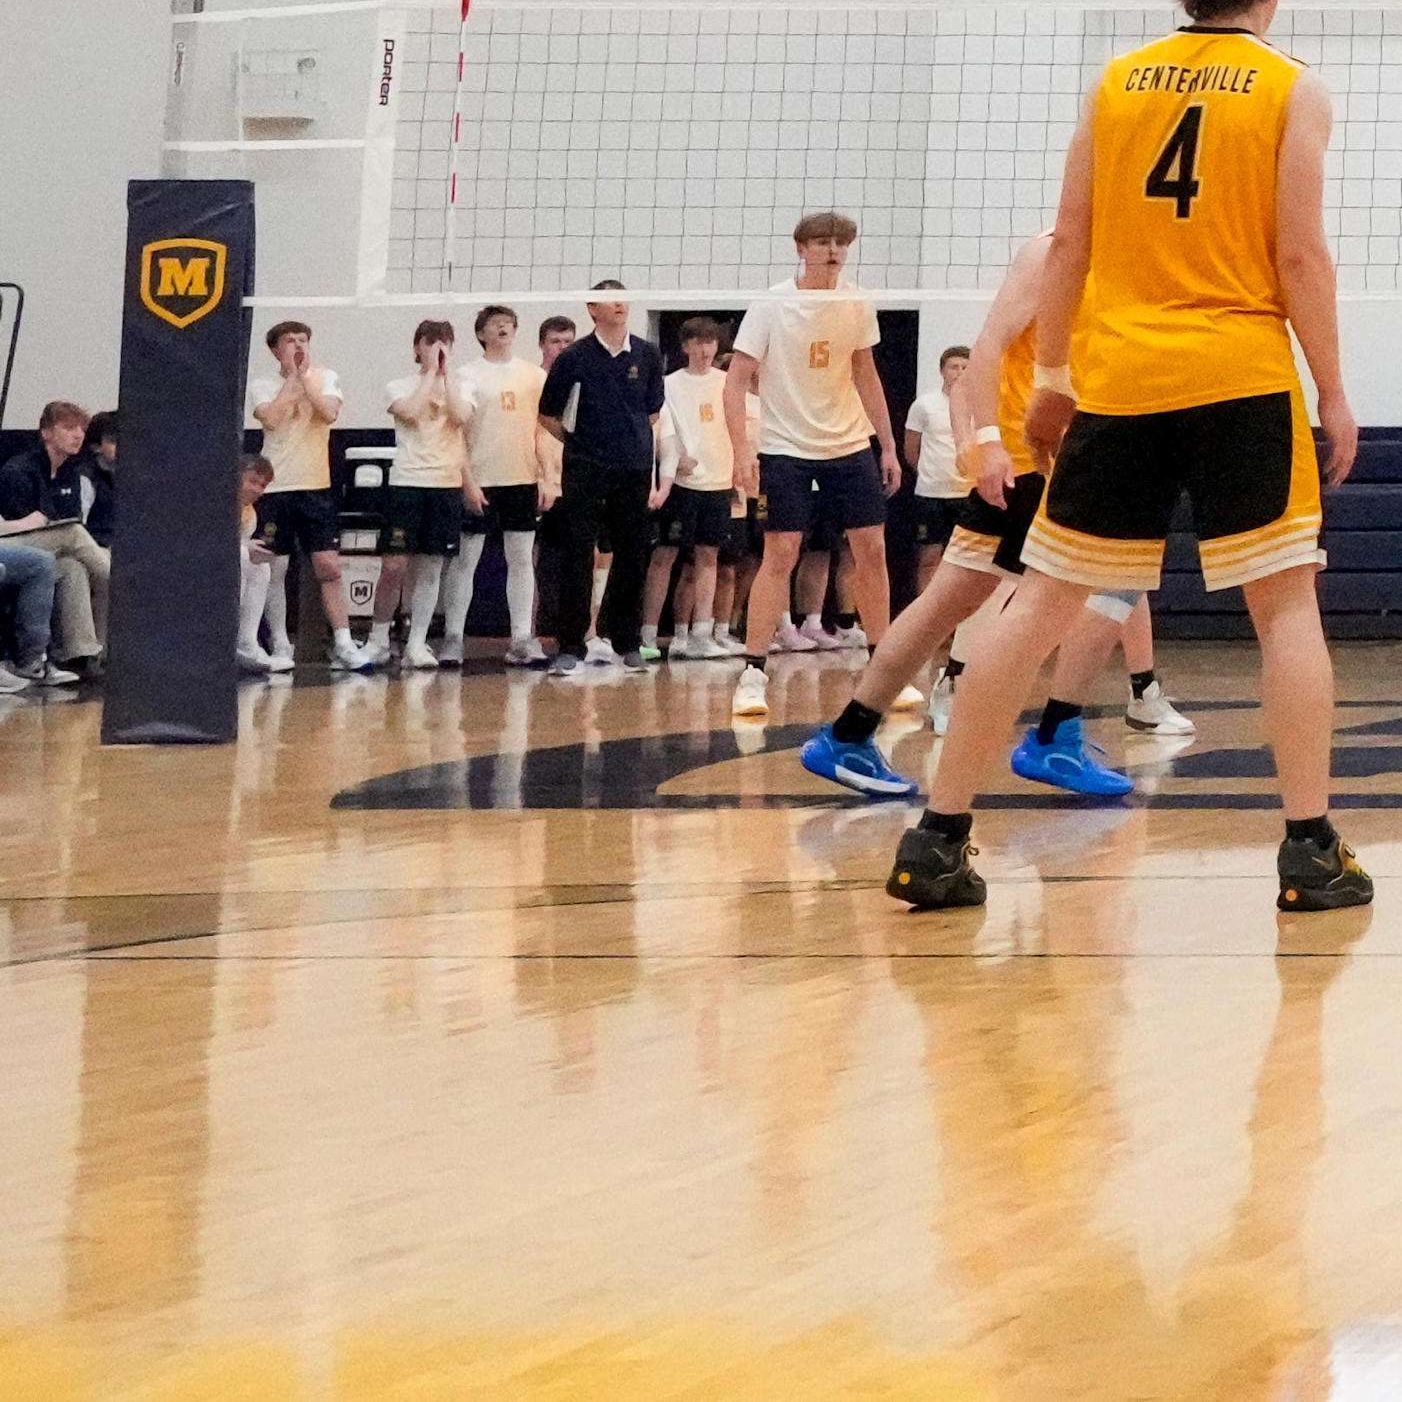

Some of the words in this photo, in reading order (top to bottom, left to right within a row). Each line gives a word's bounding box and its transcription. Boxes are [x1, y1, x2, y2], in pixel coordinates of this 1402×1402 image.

[1145, 102, 1205, 220] 4
[157, 258, 210, 296] M
[809, 341, 830, 368] 15
